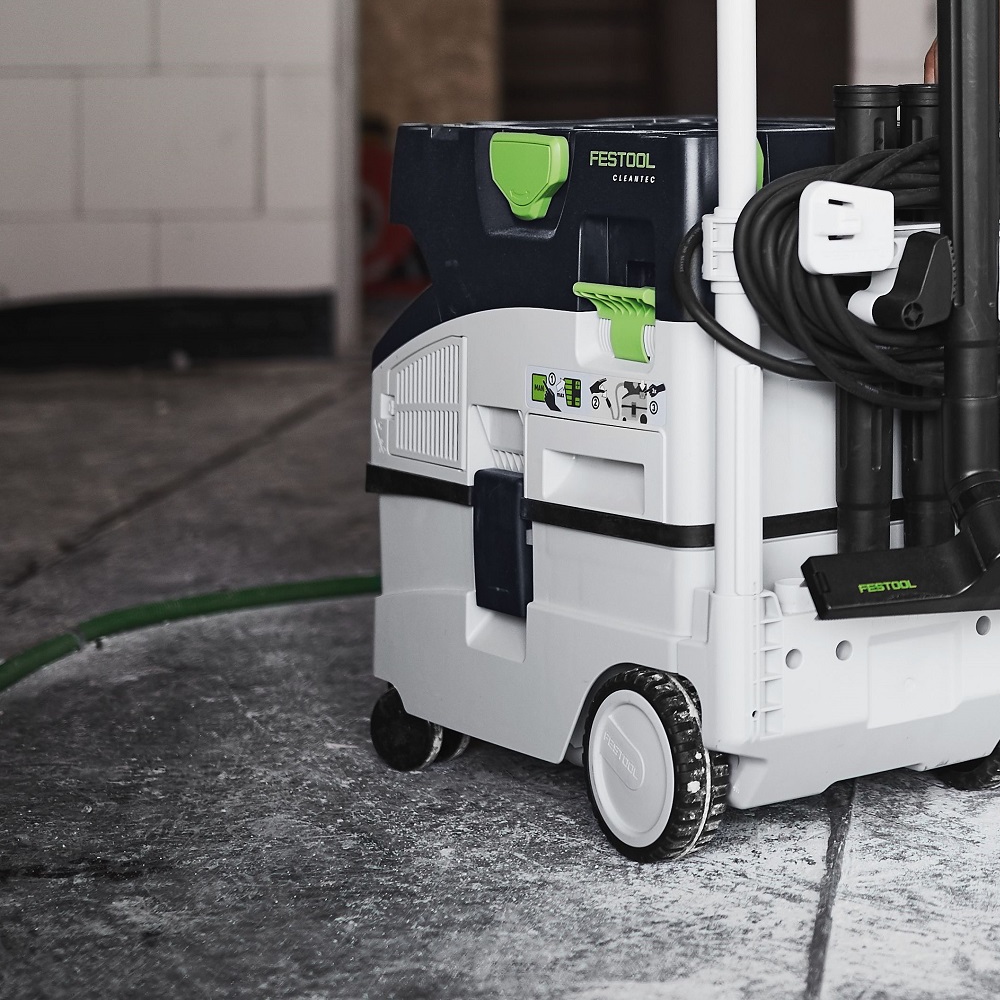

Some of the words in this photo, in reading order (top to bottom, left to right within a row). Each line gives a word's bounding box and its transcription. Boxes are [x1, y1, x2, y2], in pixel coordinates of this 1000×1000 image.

[589, 151, 656, 169] FESTOOL
[612, 174, 656, 184] CLEANTEC
[858, 580, 917, 594] FESTOOL
[604, 731, 639, 780] FESTOOL
